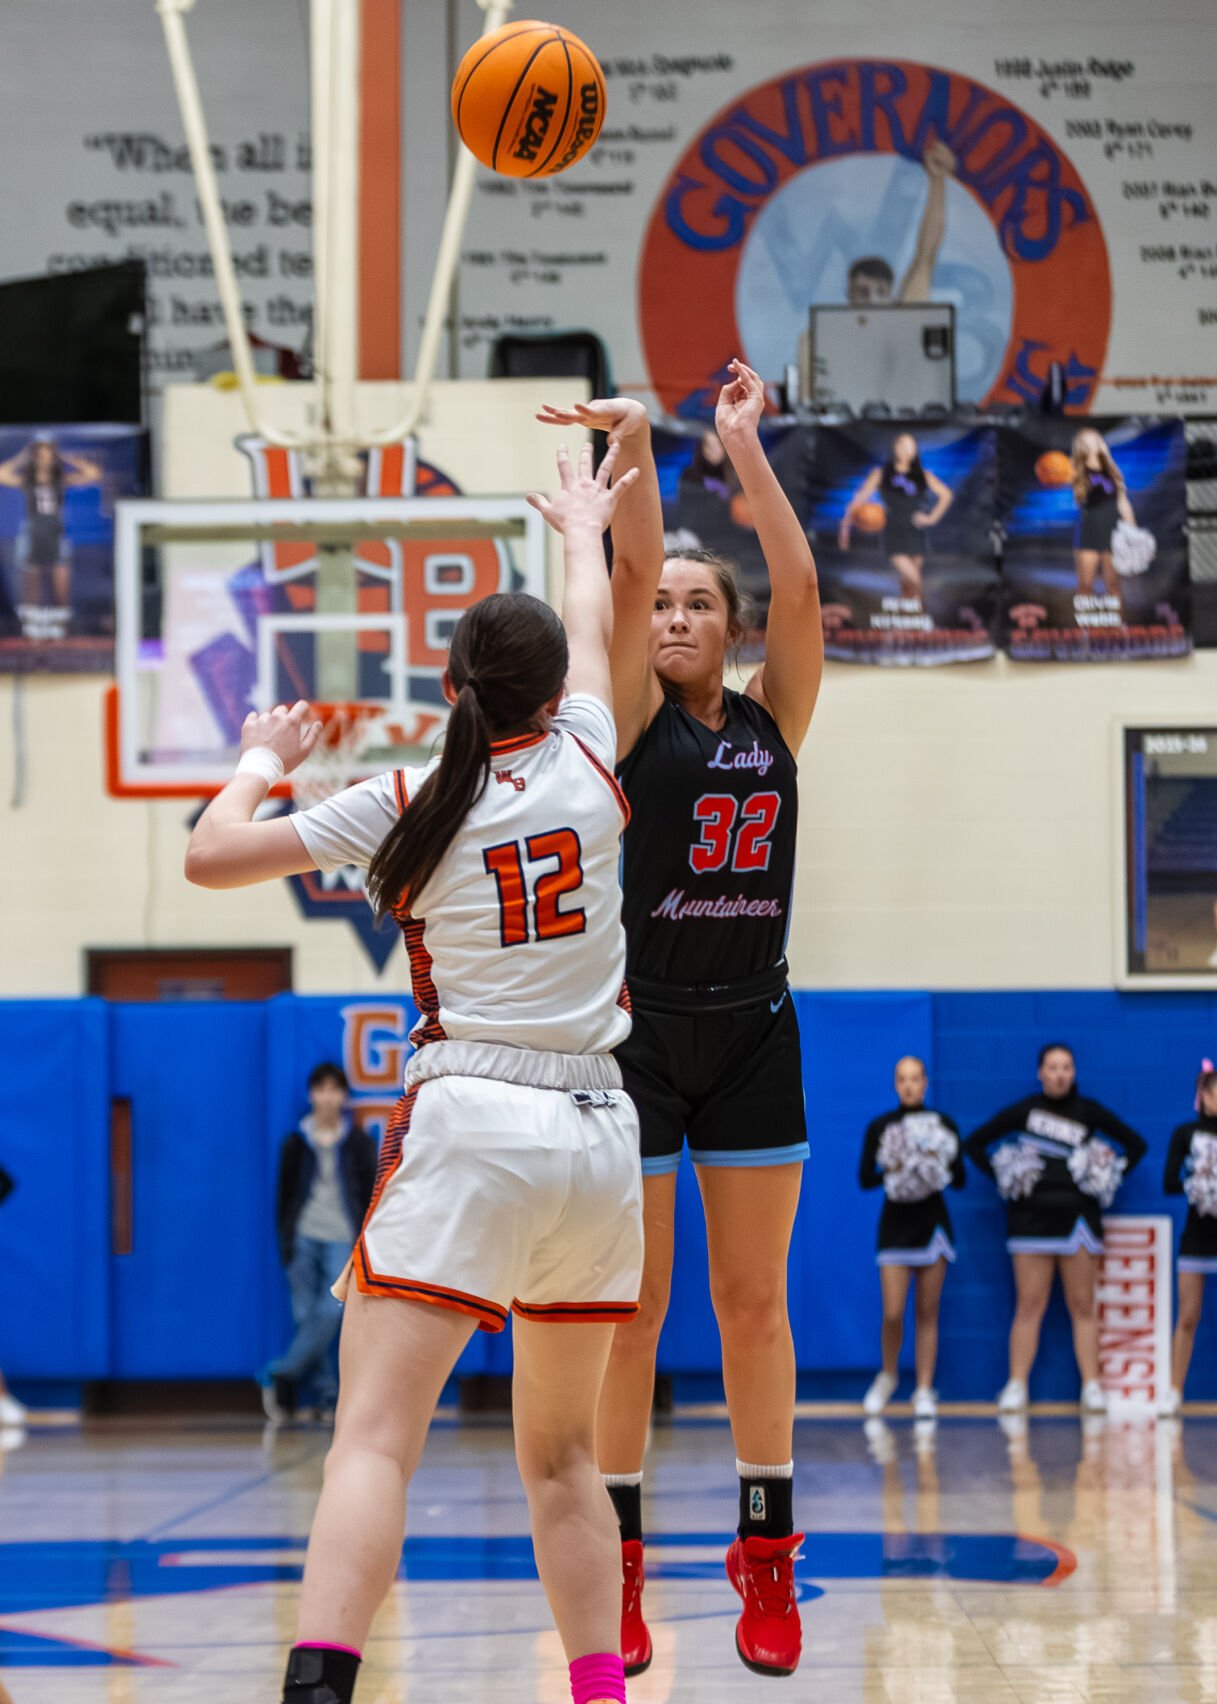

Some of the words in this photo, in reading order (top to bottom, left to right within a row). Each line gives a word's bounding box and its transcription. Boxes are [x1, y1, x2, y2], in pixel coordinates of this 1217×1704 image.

[513, 86, 558, 164] NCAA
[664, 61, 1092, 262] GOVERNORS
[707, 740, 774, 776] Lady
[689, 791, 782, 874] 32
[482, 827, 587, 948] 12
[1097, 1226, 1156, 1403] DEFENSE
